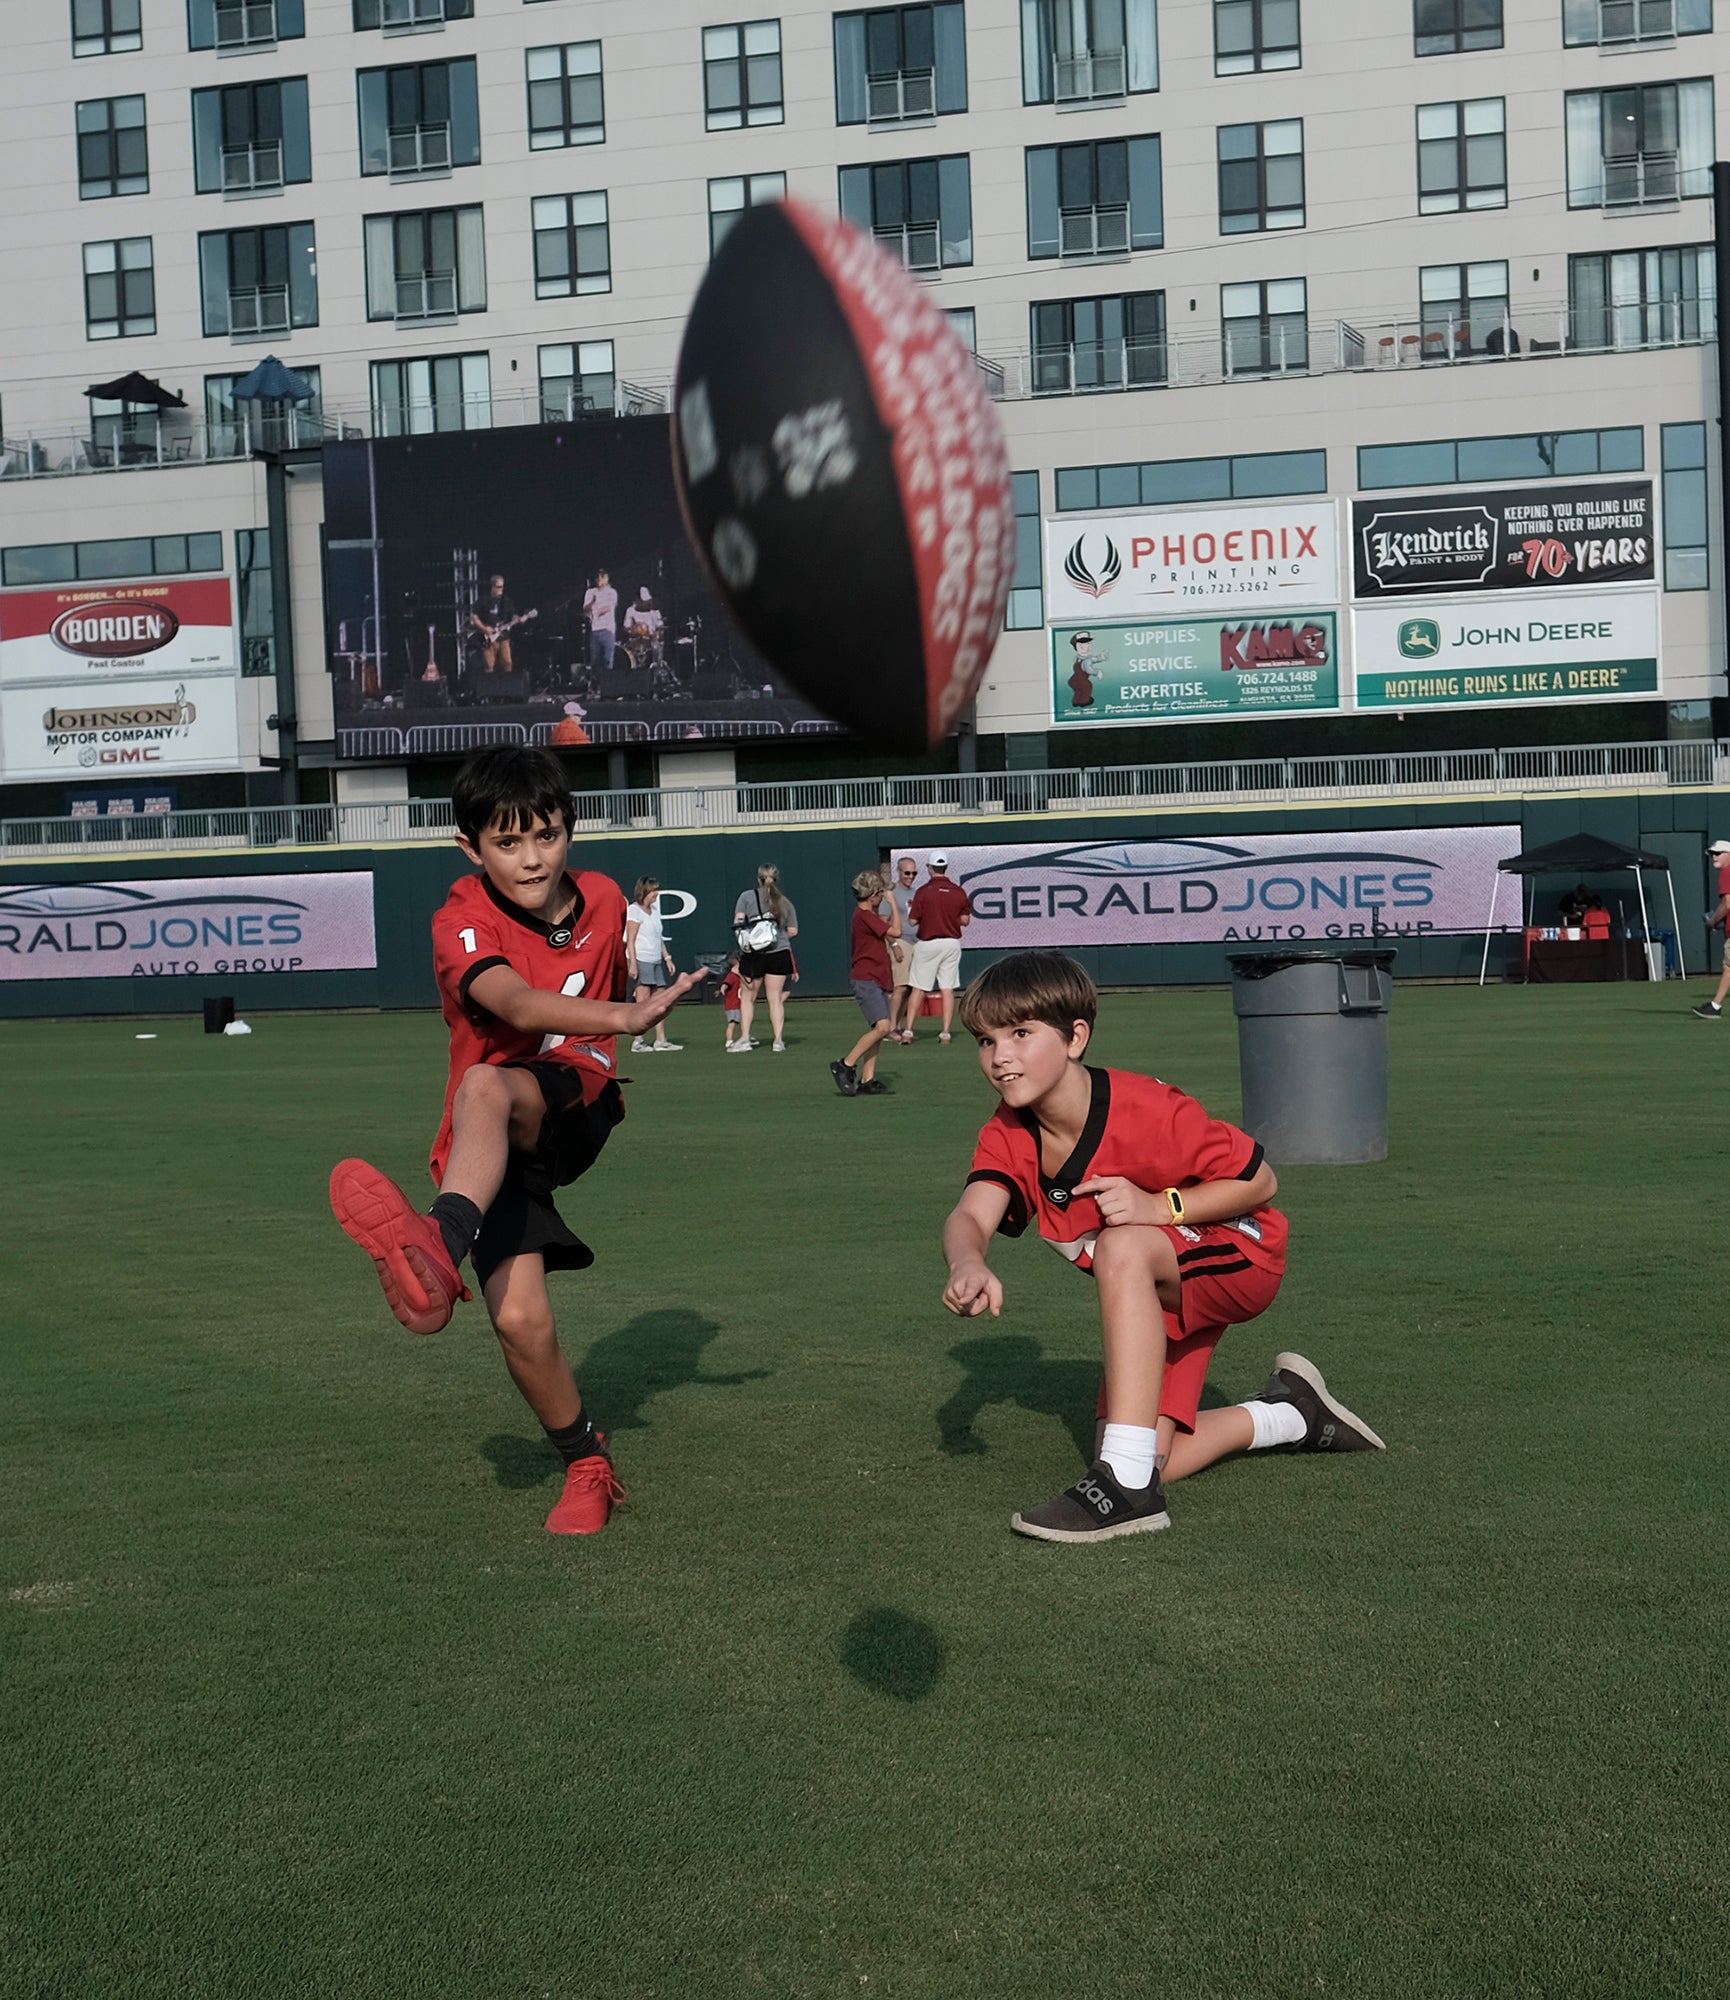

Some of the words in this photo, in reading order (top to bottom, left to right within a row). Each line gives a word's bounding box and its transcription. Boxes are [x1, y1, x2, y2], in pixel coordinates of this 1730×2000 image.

[1504, 505, 1549, 520] KEEPING
[1552, 503, 1572, 517] YOU
[1576, 500, 1620, 516] ROLLING
[1623, 498, 1647, 513] LIKE
[1508, 520, 1553, 535] NOTHING
[1557, 518, 1584, 532] EVER
[1587, 514, 1643, 530] HAPPENED
[1131, 525, 1318, 568] PHOENIX
[1372, 522, 1489, 569] Kendrick
[1574, 538, 1648, 573] YEARS
[1410, 556, 1442, 565] PAINT
[1455, 553, 1485, 562] BODY
[1150, 564, 1301, 583] PRINTING
[1182, 581, 1269, 595] 706.722.5262
[67, 613, 161, 644] BORDEN
[1124, 629, 1200, 646] SUPPLIES.
[1451, 625, 1521, 647] JOHN
[1528, 621, 1613, 641] DEERE
[1220, 627, 1326, 671] KAMO
[88, 659, 108, 669] Pest
[111, 658, 145, 668] Control
[1129, 656, 1198, 672] SERVICE.
[1236, 671, 1317, 686] 706.724.1488
[1260, 684, 1302, 694] REYNOLDS
[1385, 676, 1459, 699] NOTHING
[1464, 674, 1507, 696] RUNS
[1512, 671, 1548, 692] LIKE
[1552, 671, 1562, 690] A
[1120, 682, 1208, 701] EXPERTISE.
[1105, 703, 1149, 714] Products
[1152, 701, 1169, 711] for
[44, 706, 175, 731] JOHNSON
[47, 731, 97, 746] MOTOR
[101, 727, 173, 743] COMPANY
[99, 746, 161, 763] GMC
[968, 879, 1219, 920] GERALD
[1222, 872, 1434, 912] JONES
[130, 914, 303, 950] JONES
[458, 927, 478, 954] 1
[1223, 924, 1306, 941] AUTO
[1325, 920, 1435, 939] GROUP
[131, 961, 199, 977] AUTO
[214, 957, 304, 972] GROUP
